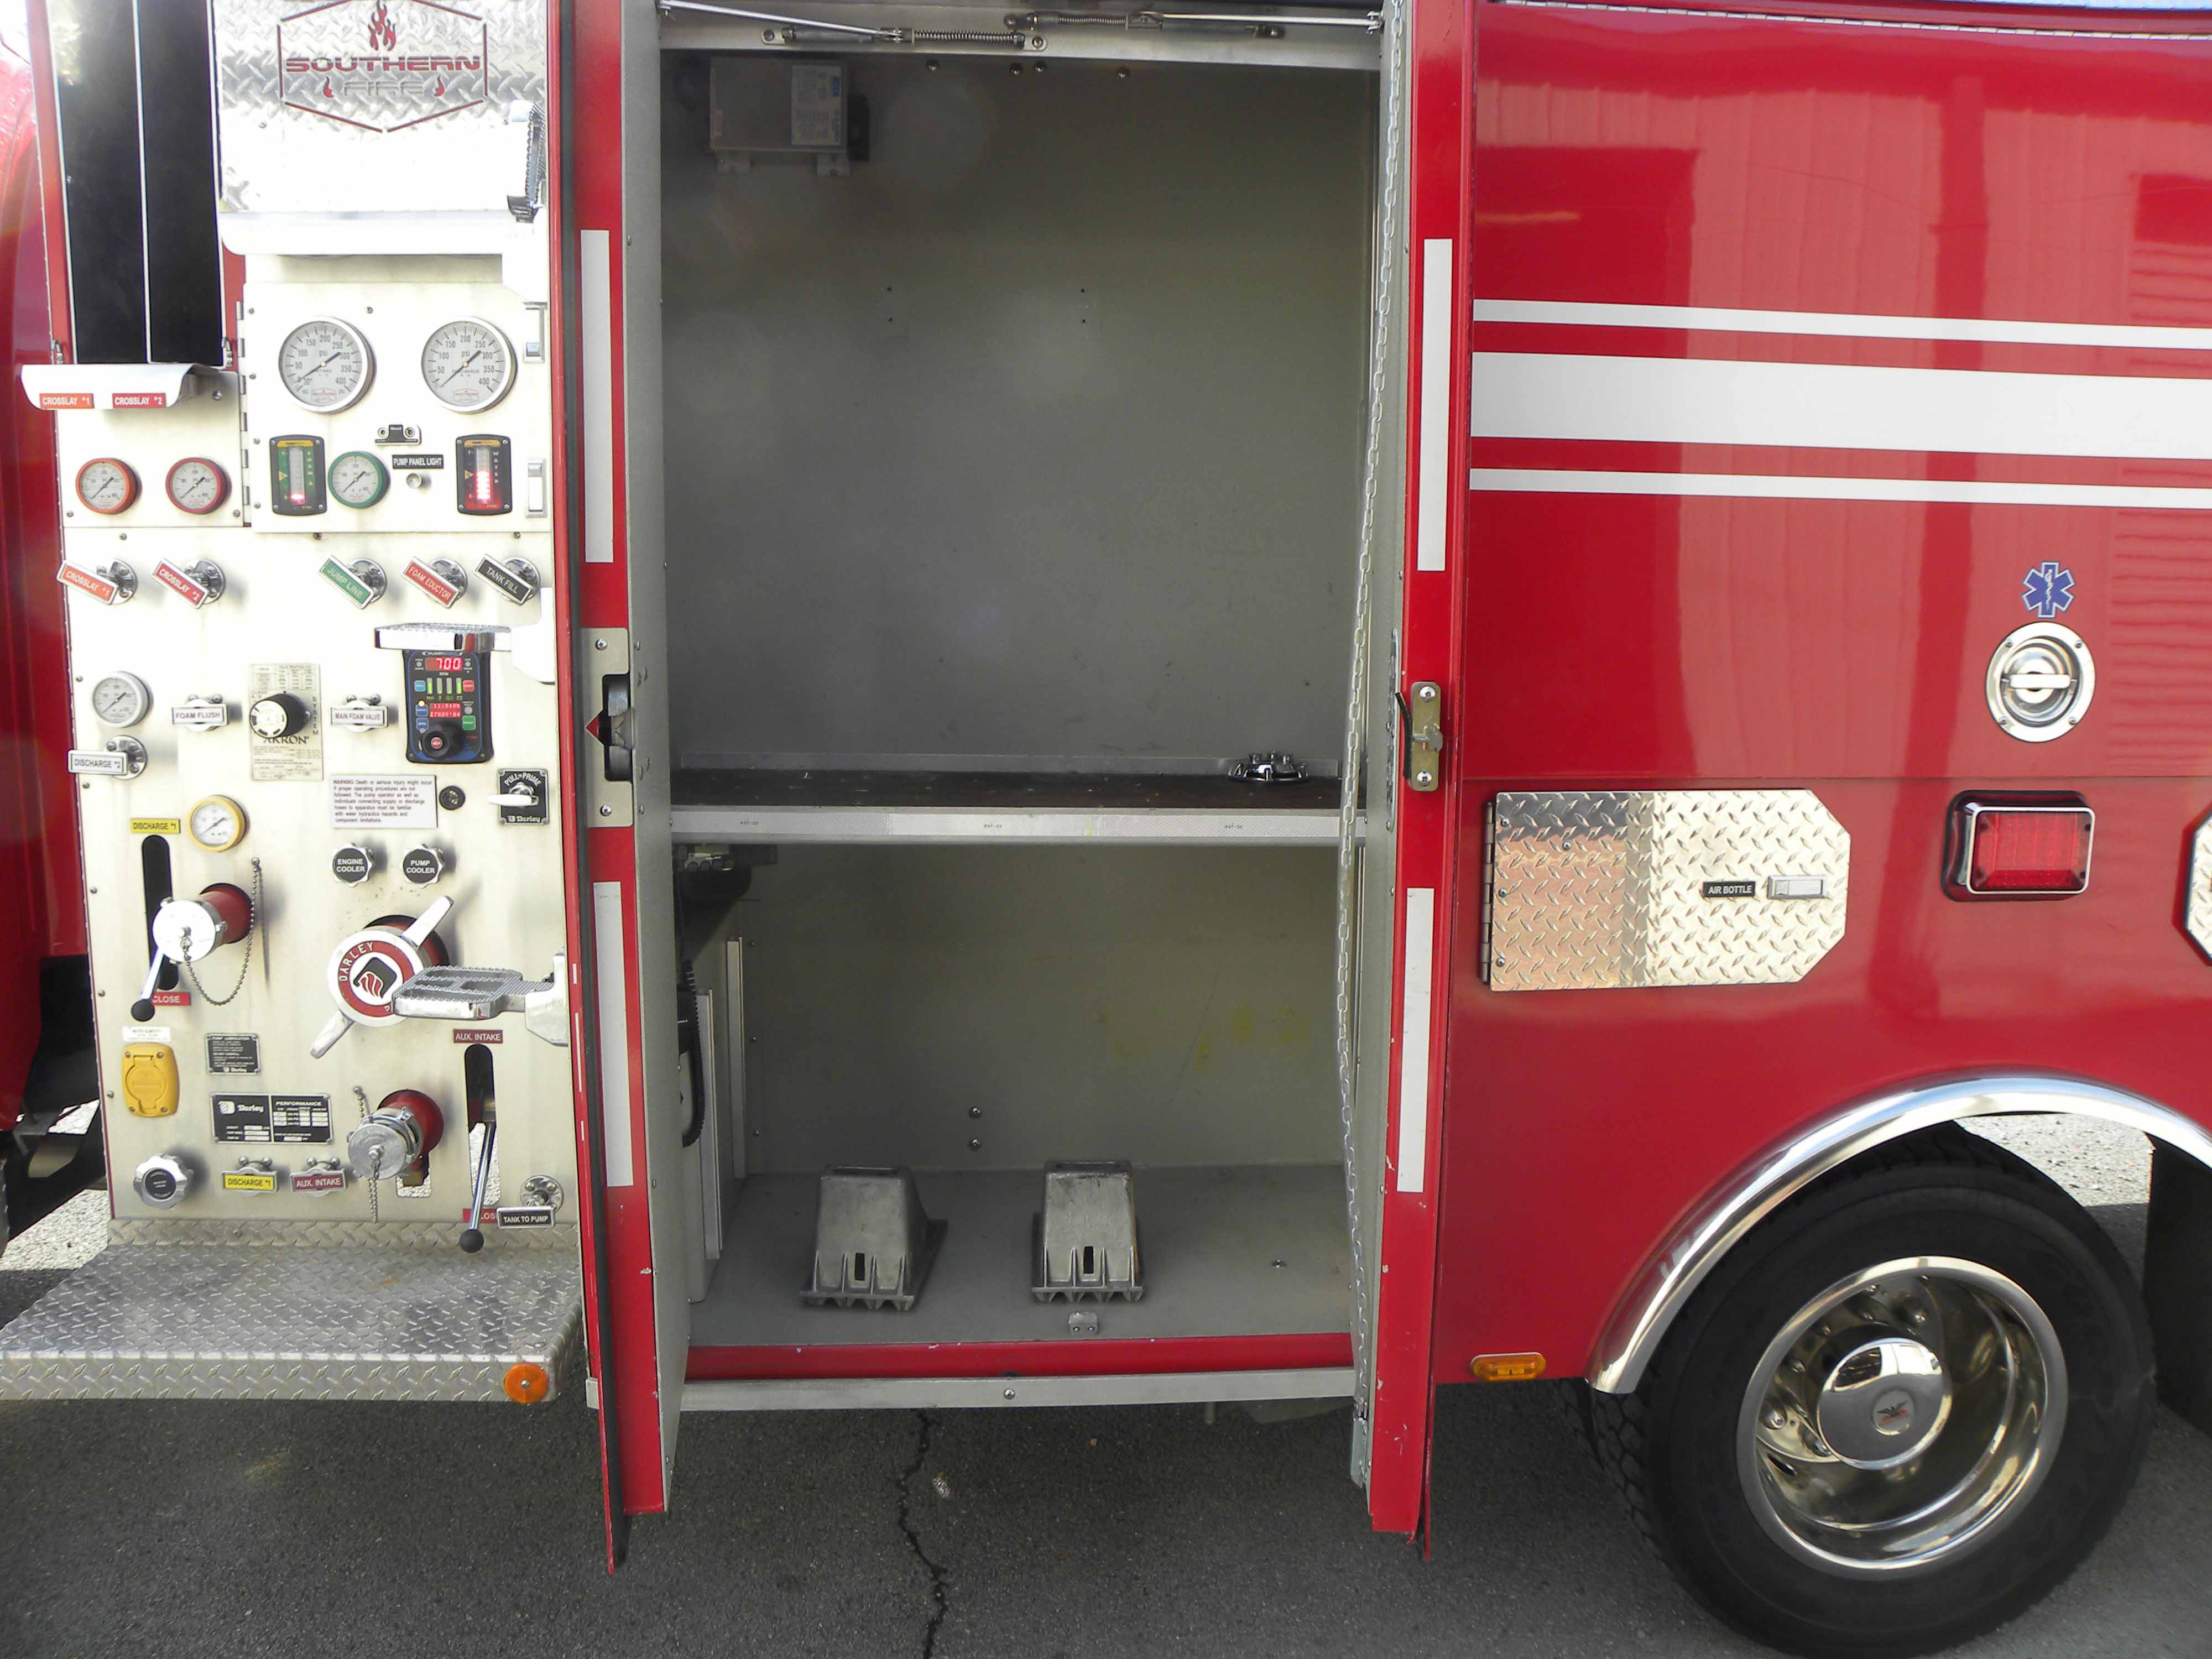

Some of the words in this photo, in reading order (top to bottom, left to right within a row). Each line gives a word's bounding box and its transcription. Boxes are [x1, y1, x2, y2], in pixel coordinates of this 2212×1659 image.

[285, 56, 481, 72] SOUTHERN
[343, 80, 424, 97] FIRE
[409, 458, 426, 466] PANEL
[65, 571, 98, 592] CROSSLAY
[159, 568, 190, 593] CROSSLAY
[327, 567, 348, 585] JUMP
[346, 582, 363, 598] LINE
[409, 567, 426, 581] FOAM
[425, 577, 451, 601] EDUCTOR
[487, 567, 505, 582] TANK
[503, 580, 518, 594] FILL
[436, 657, 461, 670] 700
[74, 758, 112, 768] DISCHARGE
[504, 773, 519, 786] PULL
[522, 772, 542, 786] PRIME
[1708, 886, 1721, 894] AIR
[1723, 885, 1752, 894] BOTTLE
[339, 942, 373, 982] DARLEY
[237, 1104, 264, 1113] Darley
[227, 1178, 263, 1187] DISCHARGE
[315, 1178, 341, 1186] INTAKE
